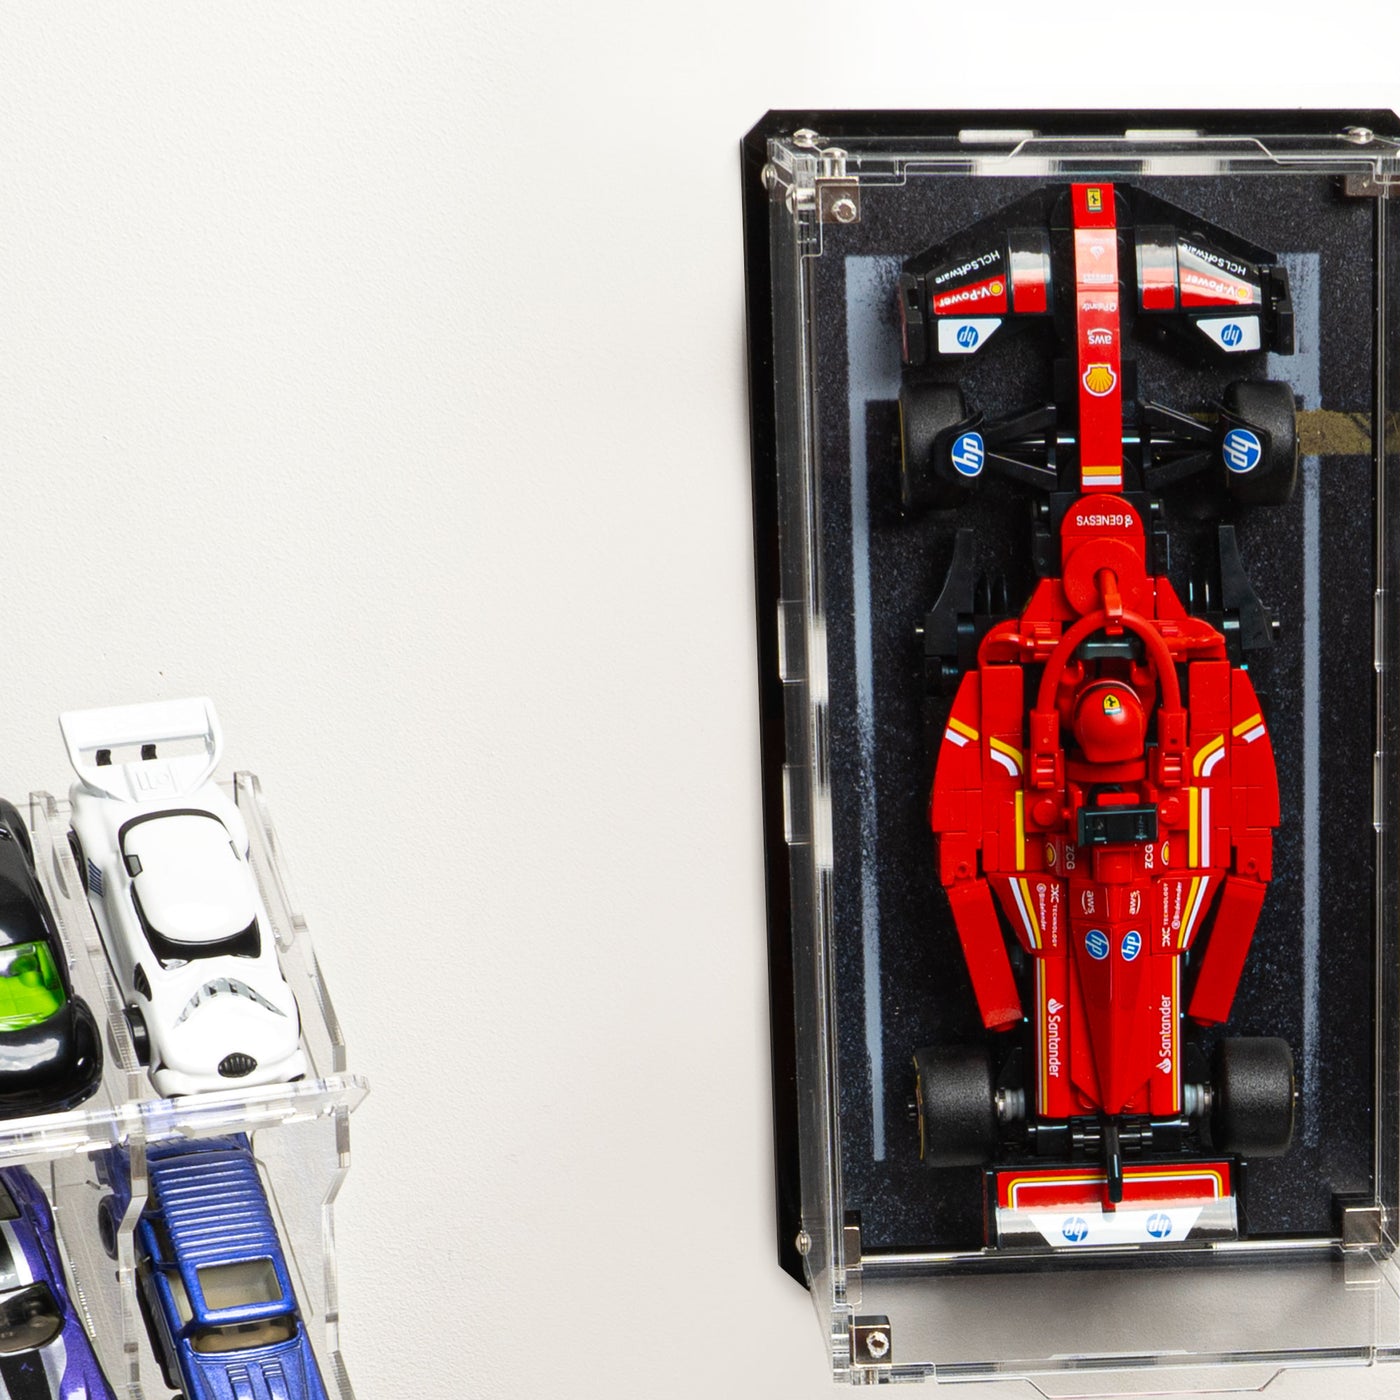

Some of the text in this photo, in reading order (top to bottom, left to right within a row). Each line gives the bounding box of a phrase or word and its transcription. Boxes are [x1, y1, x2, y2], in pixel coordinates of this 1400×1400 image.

[935, 250, 1001, 284] HCLSoftware
[1182, 241, 1247, 276] HCLSoftware
[939, 287, 991, 308] V-Power
[1186, 274, 1236, 297] V-Power
[957, 325, 979, 348] hp
[1221, 324, 1243, 346] hp
[951, 432, 984, 477] hp
[1222, 428, 1261, 473] hp
[1076, 515, 1124, 526] GENESYS
[1144, 844, 1154, 870] ZCG
[1085, 929, 1110, 960] hp
[1121, 930, 1142, 961] hp
[1158, 995, 1171, 1057] Santander
[1048, 1015, 1062, 1078] Santander
[1062, 1216, 1088, 1242] hp
[1146, 1213, 1172, 1238] hp
